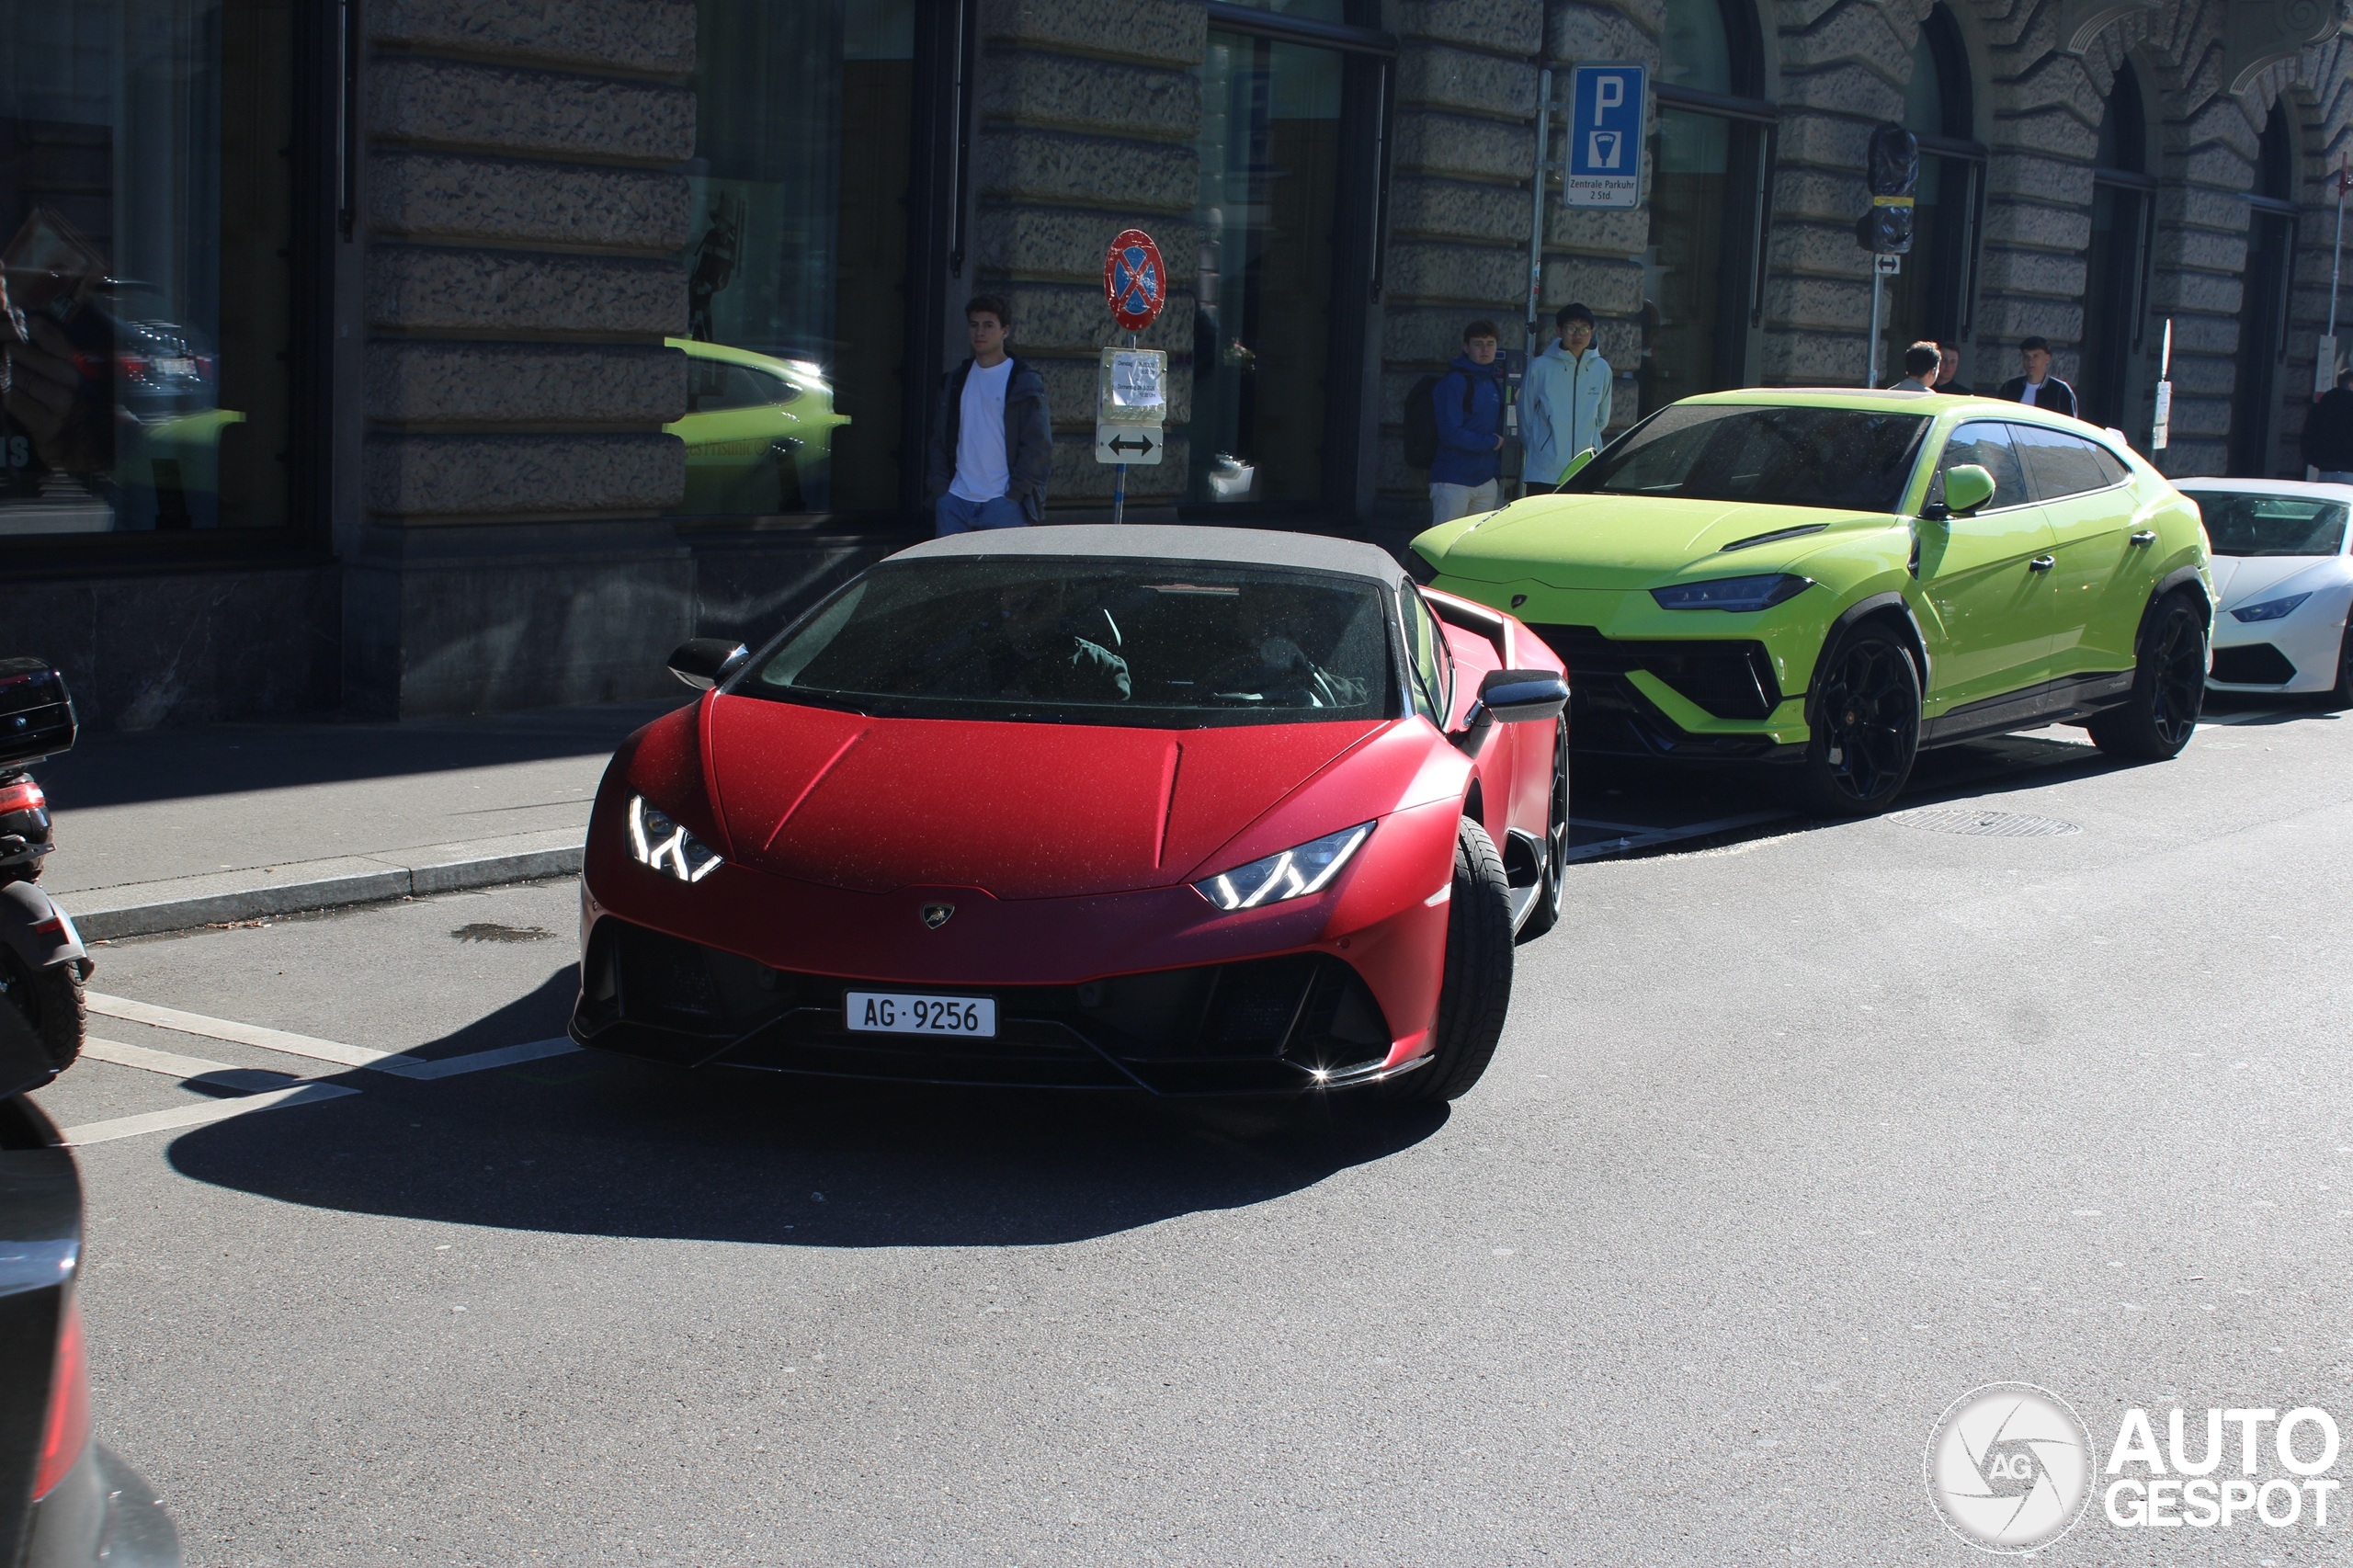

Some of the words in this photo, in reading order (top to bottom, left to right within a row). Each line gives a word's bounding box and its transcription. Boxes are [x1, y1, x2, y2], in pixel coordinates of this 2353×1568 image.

[1594, 75, 1624, 127] P
[1570, 179, 1602, 188] Zentrale
[1605, 180, 1635, 189] Parkuhr
[1590, 191, 1595, 199] 2
[1597, 191, 1612, 199] Std.
